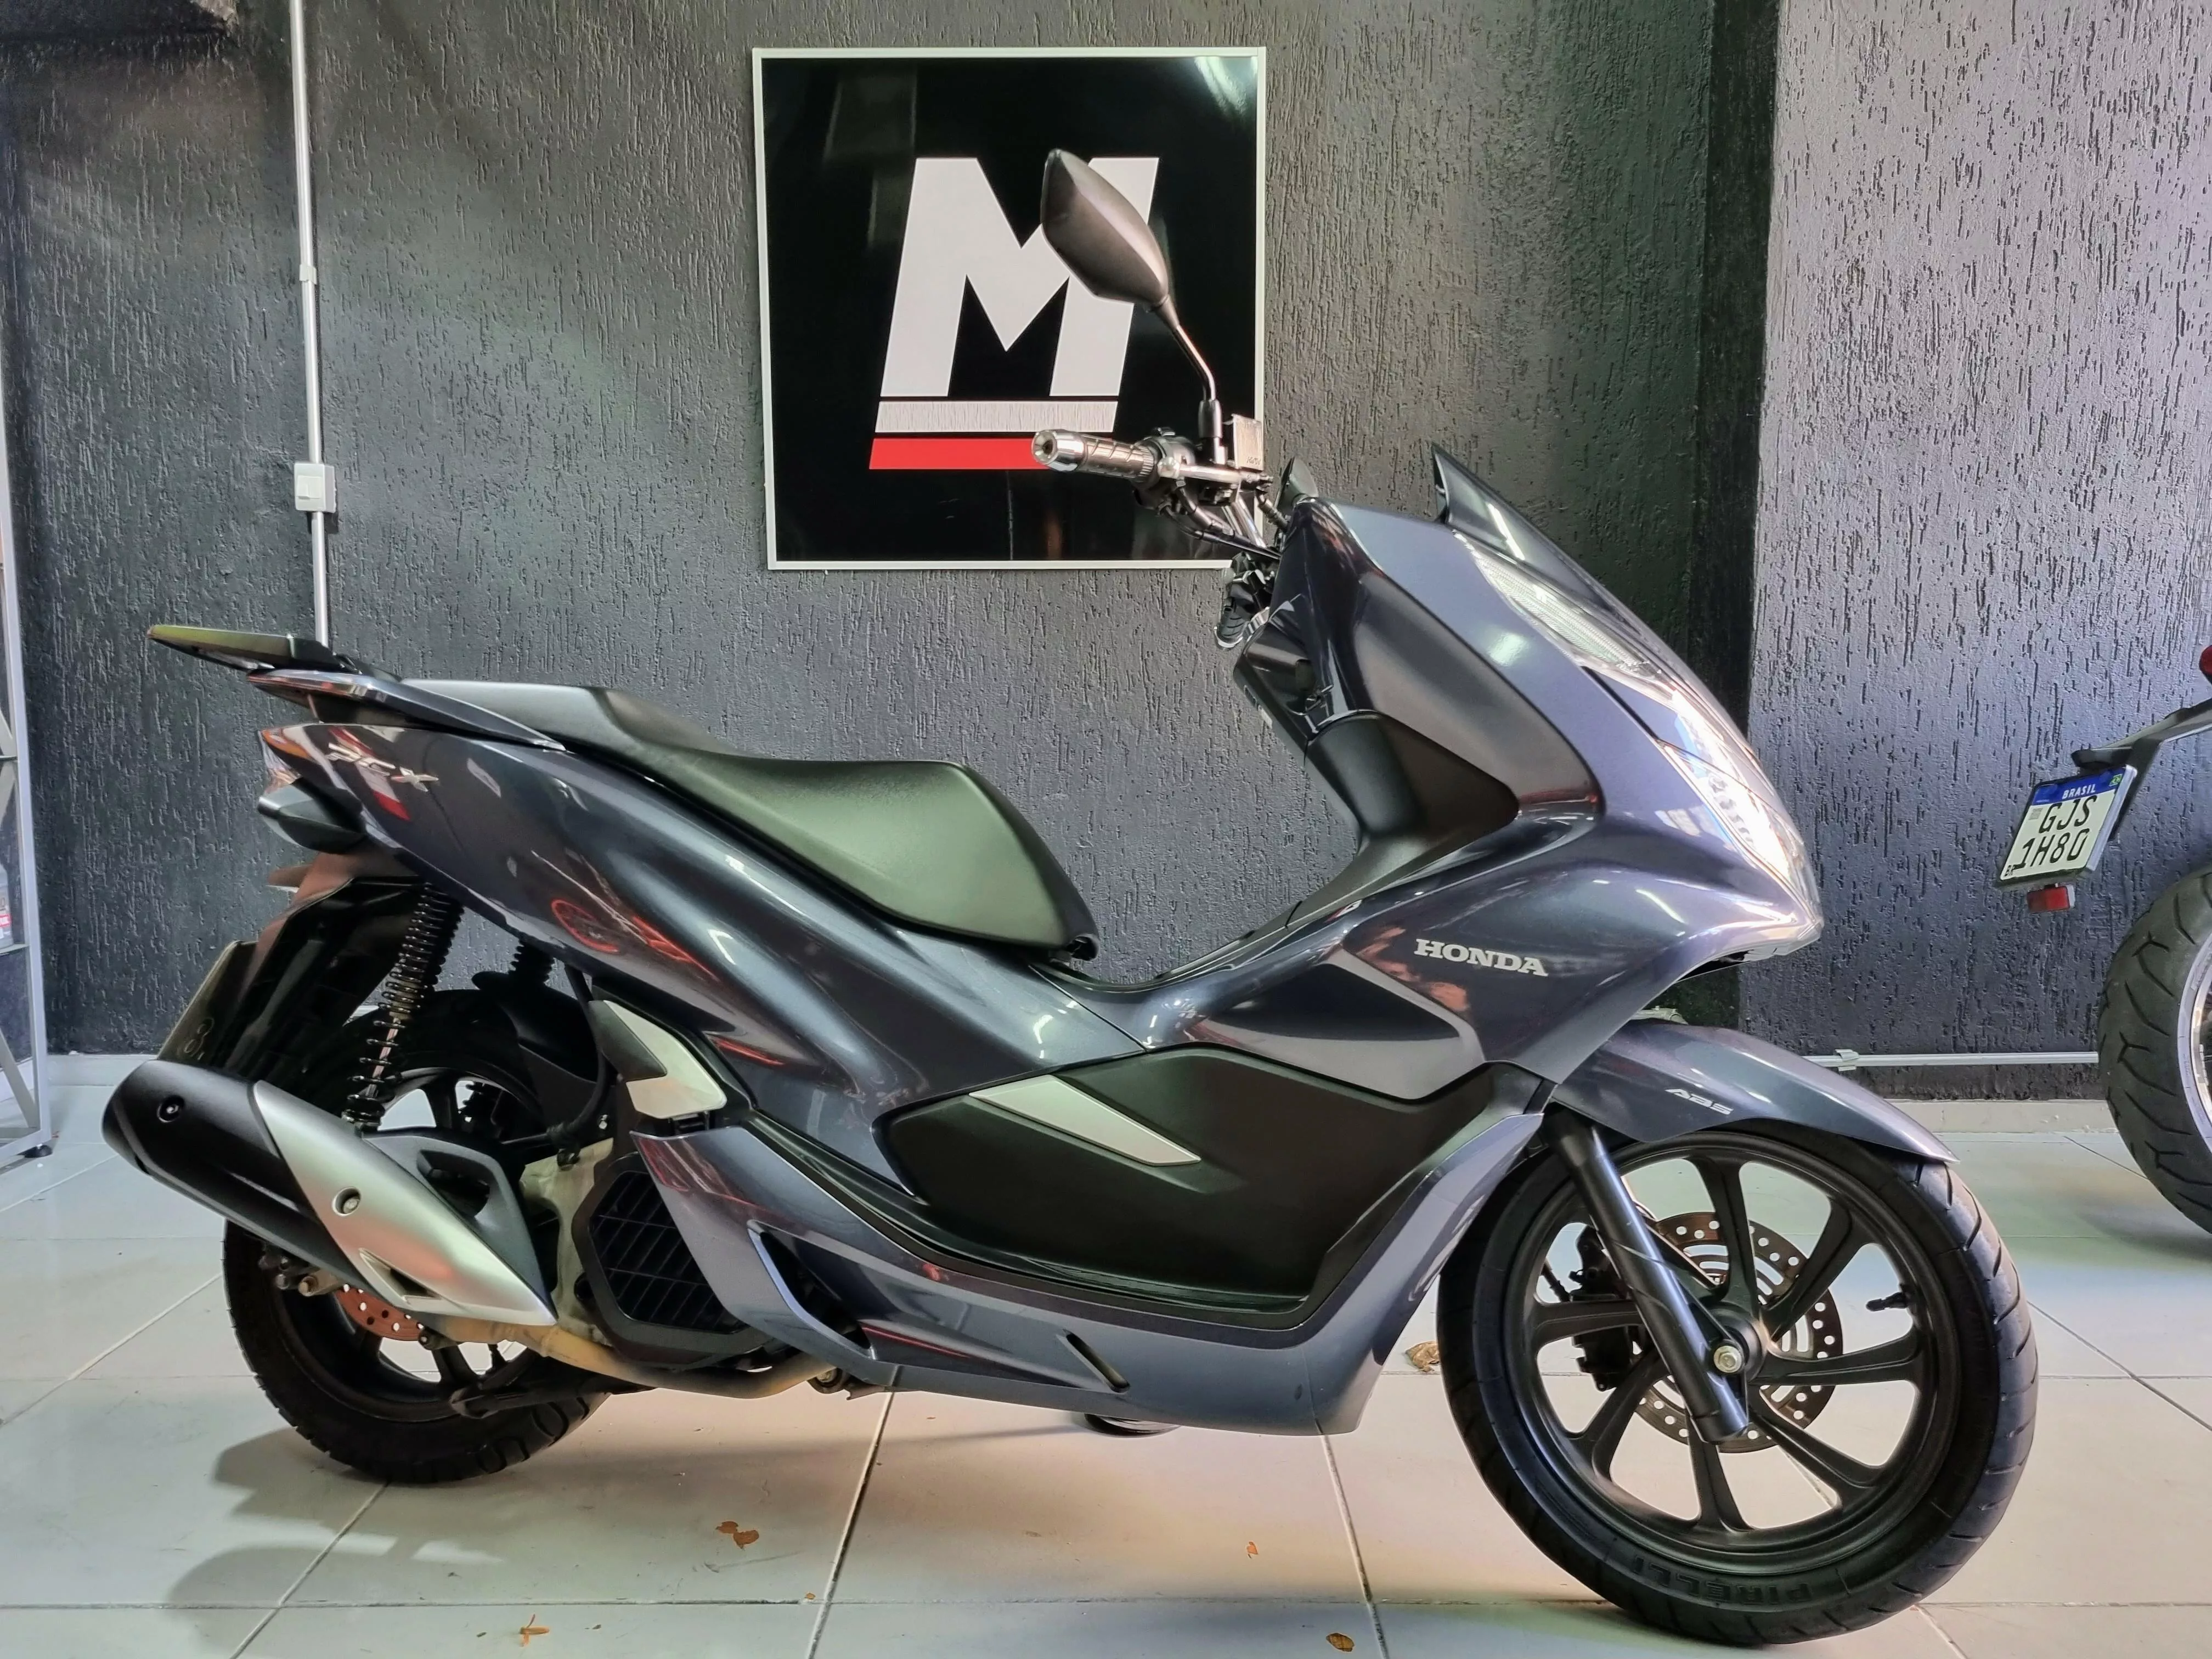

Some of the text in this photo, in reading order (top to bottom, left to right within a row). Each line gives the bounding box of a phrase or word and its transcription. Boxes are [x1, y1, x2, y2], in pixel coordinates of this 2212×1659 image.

[880, 157, 1159, 397] M
[2062, 783, 2096, 800] BRASIL
[2039, 795, 2097, 834] GJS
[2012, 828, 2090, 870] 1H80
[1414, 939, 1549, 977] HONDA
[1664, 1088, 1734, 1115] ABS
[1632, 1556, 1814, 1605] PIRELLI
